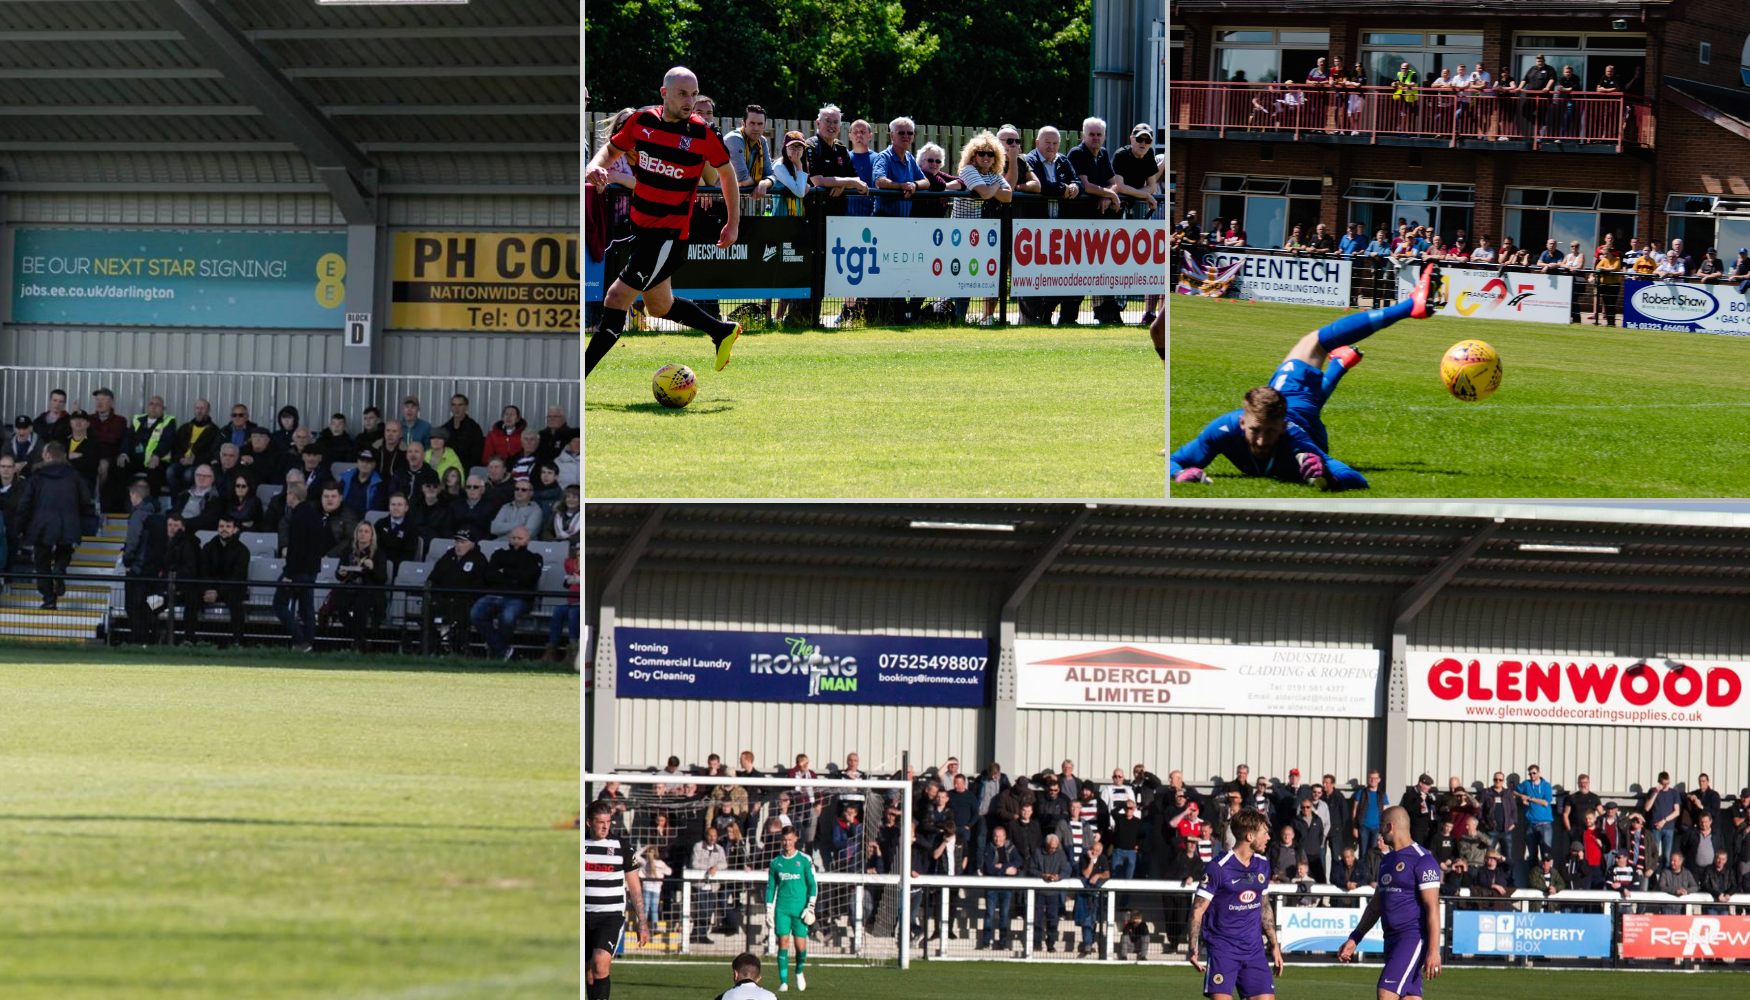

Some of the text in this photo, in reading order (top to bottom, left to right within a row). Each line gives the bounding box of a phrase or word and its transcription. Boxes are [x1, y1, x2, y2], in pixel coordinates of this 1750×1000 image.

[647, 156, 684, 179] Ebac
[687, 244, 748, 260] AVECSPORT.COM
[1014, 228, 1165, 266] GLENWOOD
[413, 238, 476, 278] PH
[832, 236, 924, 285] tgi MEDIA
[22, 257, 287, 278] BE OUR NEXT STAR SIGNING!
[20, 283, 174, 301] jobs.ee.co.uk/darlington
[430, 285, 529, 300] NATIONWIDE
[1261, 282, 1271, 291] TO
[1273, 283, 1324, 295] DARLINGTON
[1642, 293, 1707, 307] Robert Shaw
[348, 313, 368, 322] BLOCK
[467, 307, 508, 327] Tel:
[1721, 315, 1739, 324] GAS
[351, 323, 364, 344] D
[1639, 323, 1662, 331] 01325
[634, 642, 668, 654] Ironing
[785, 637, 813, 656] The
[634, 656, 731, 670] Commercial Laundry
[750, 654, 858, 676] IRONNG
[879, 654, 988, 671] 07525498807
[1273, 651, 1346, 664] INDUSTRIAL
[633, 670, 695, 683] Dry Cleaning
[879, 673, 979, 685] bookings@ironme.co.uk
[1065, 667, 1192, 685] ALDERCLAD
[1238, 665, 1304, 677] CLADDING
[1320, 667, 1379, 679] ROOFING
[820, 677, 858, 692] MAN
[1427, 658, 1742, 707] GLENWOOD
[1084, 687, 1172, 704] LIMITED
[1466, 704, 1702, 723] www.glenwooddecoratingsupplies.co.uk
[1241, 893, 1254, 901] KIA
[1287, 912, 1344, 929] Adams
[1516, 914, 1534, 928] MY
[1516, 928, 1585, 942] PROPERTY
[1516, 941, 1541, 953] BOX
